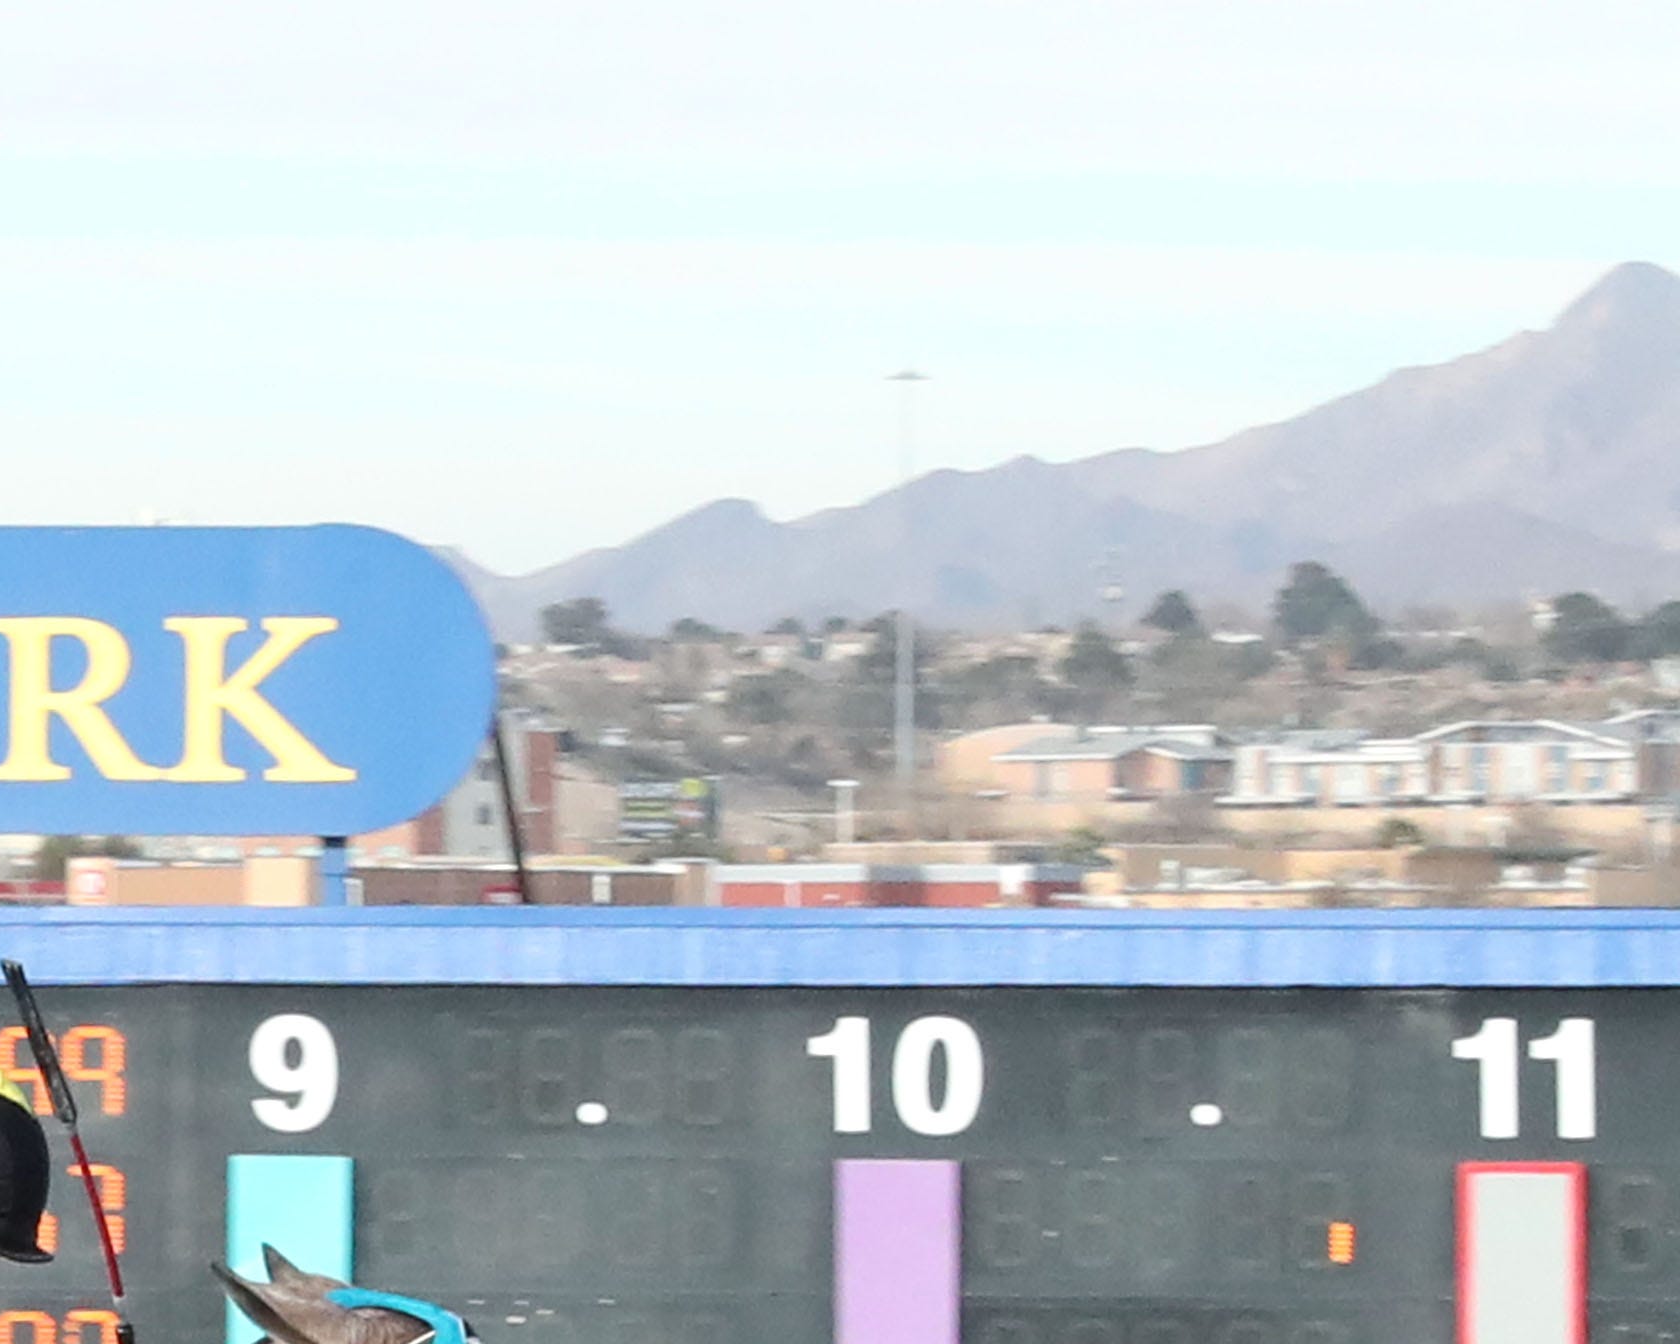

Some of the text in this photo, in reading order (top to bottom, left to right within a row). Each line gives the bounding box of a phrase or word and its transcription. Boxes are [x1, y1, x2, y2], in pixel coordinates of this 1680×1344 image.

[248, 1013, 340, 1133] 9
[805, 1015, 985, 1136] 10
[1450, 1017, 1597, 1140] 11
